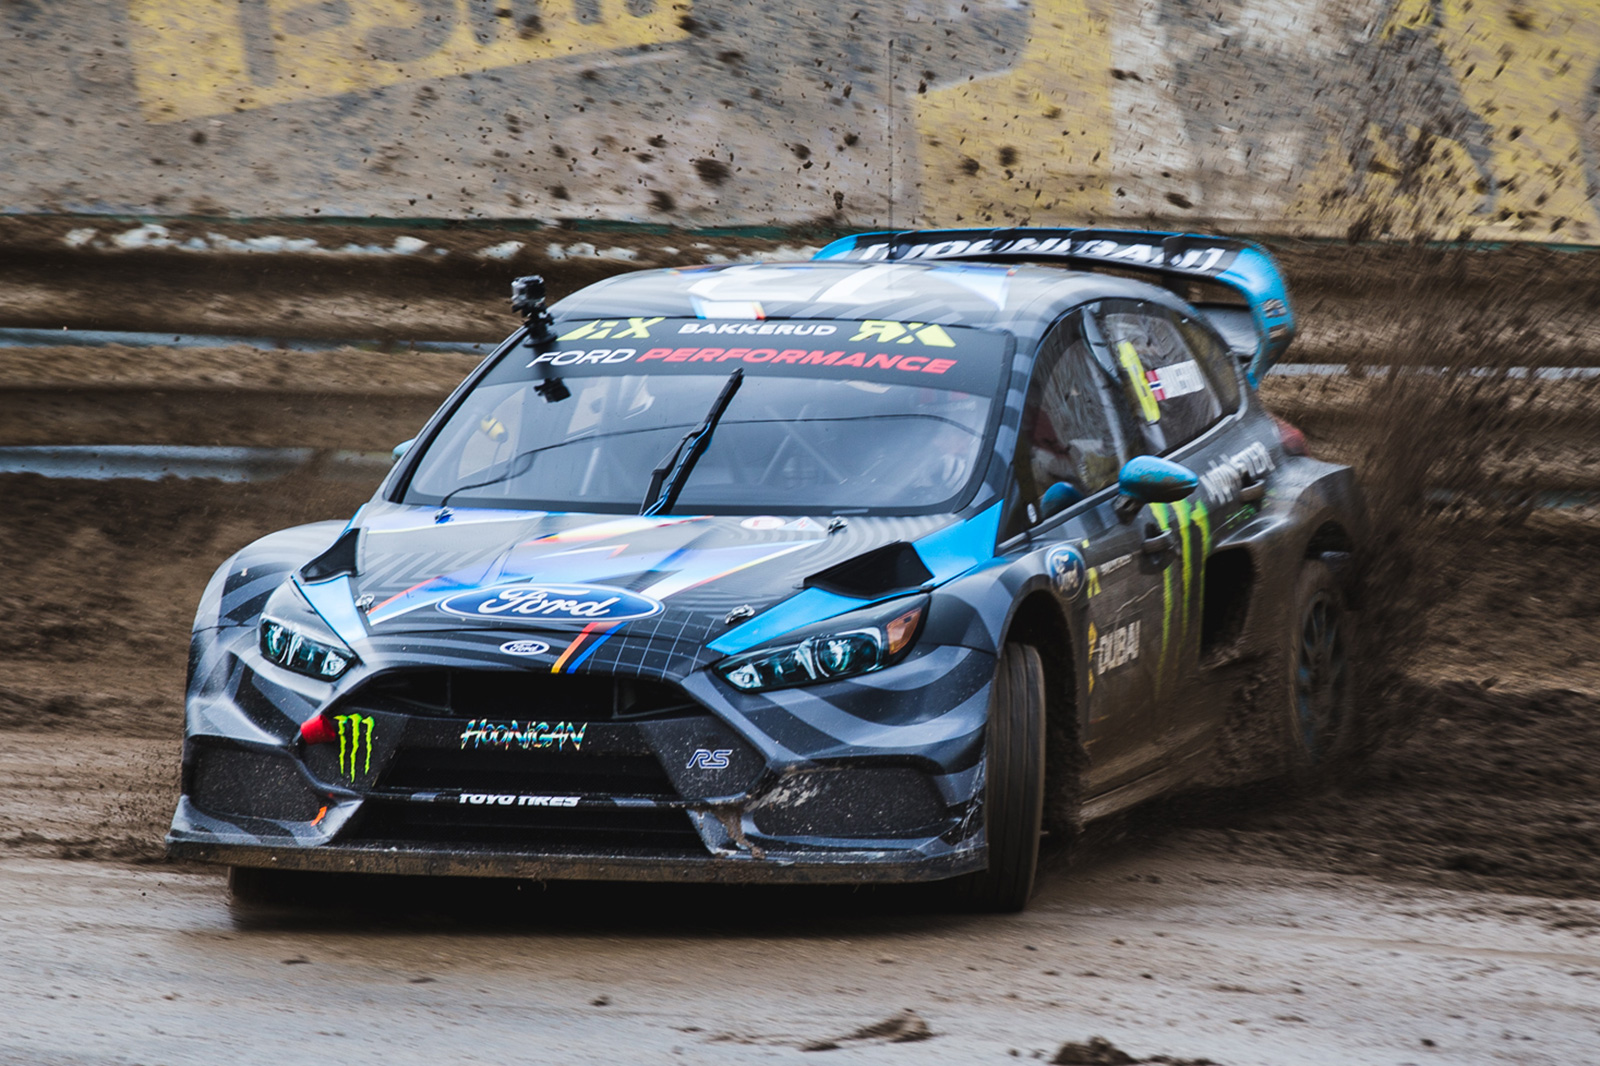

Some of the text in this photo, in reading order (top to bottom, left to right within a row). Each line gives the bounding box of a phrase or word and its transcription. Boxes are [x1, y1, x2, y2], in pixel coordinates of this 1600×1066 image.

[678, 323, 837, 337] BAKKERUD
[525, 347, 957, 374] FORD PERFORMANCE
[476, 586, 622, 618] Ford
[460, 718, 588, 751] HOONIGAN
[686, 748, 733, 769] RS
[459, 793, 582, 808] TOYO TIRES
